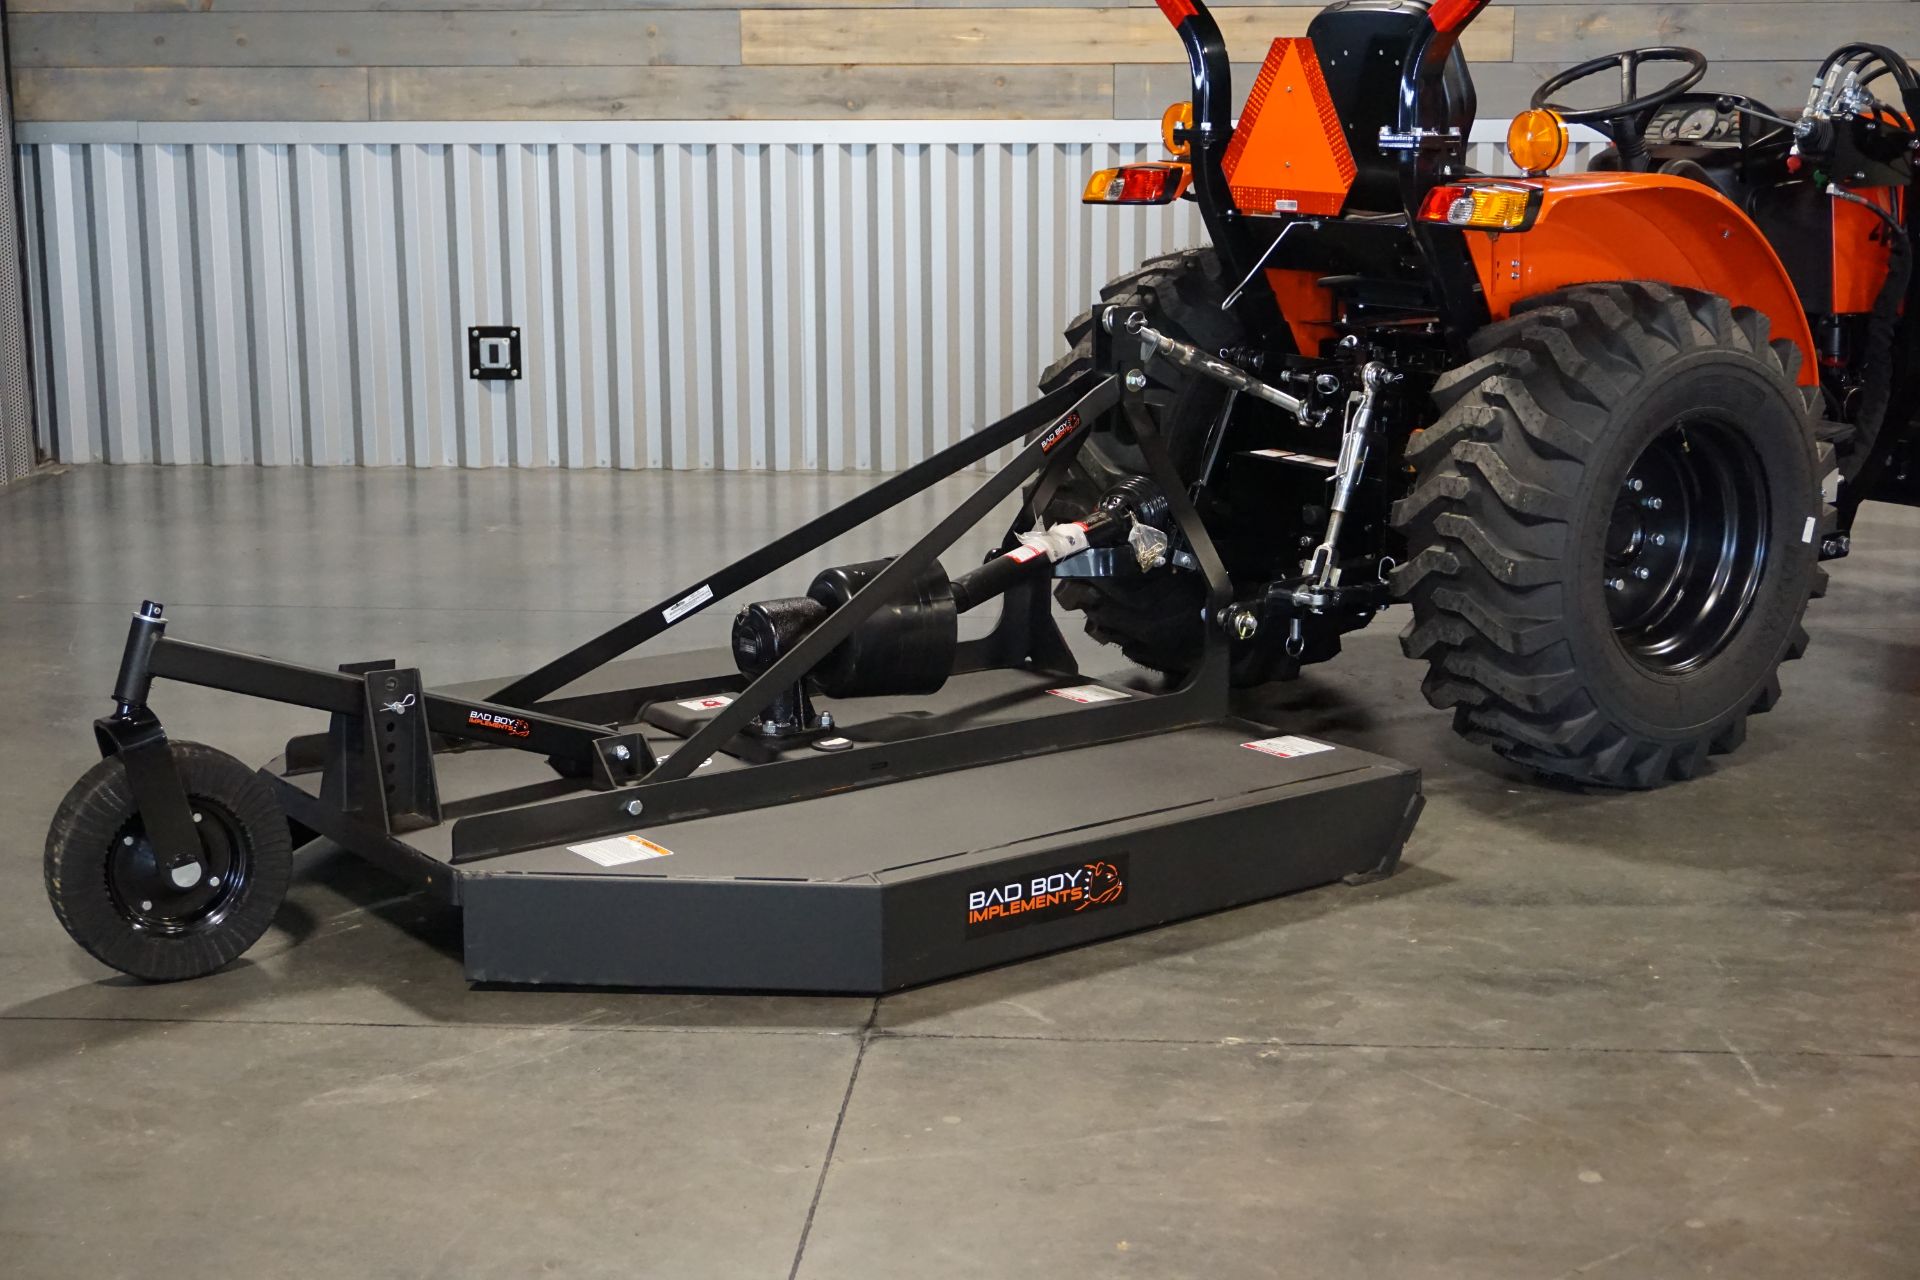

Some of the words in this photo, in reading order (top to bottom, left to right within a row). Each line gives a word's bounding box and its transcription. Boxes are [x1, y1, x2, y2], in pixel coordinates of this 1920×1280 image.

[1041, 433, 1055, 448] BAD
[1055, 420, 1068, 435] BOY
[468, 717, 514, 731] IMPLEMENTS
[470, 711, 491, 721] BAD
[493, 715, 516, 725] BOY
[969, 883, 1022, 910] BAD
[1031, 869, 1083, 895] BOY
[969, 886, 1083, 924] IMPLEMENTS
